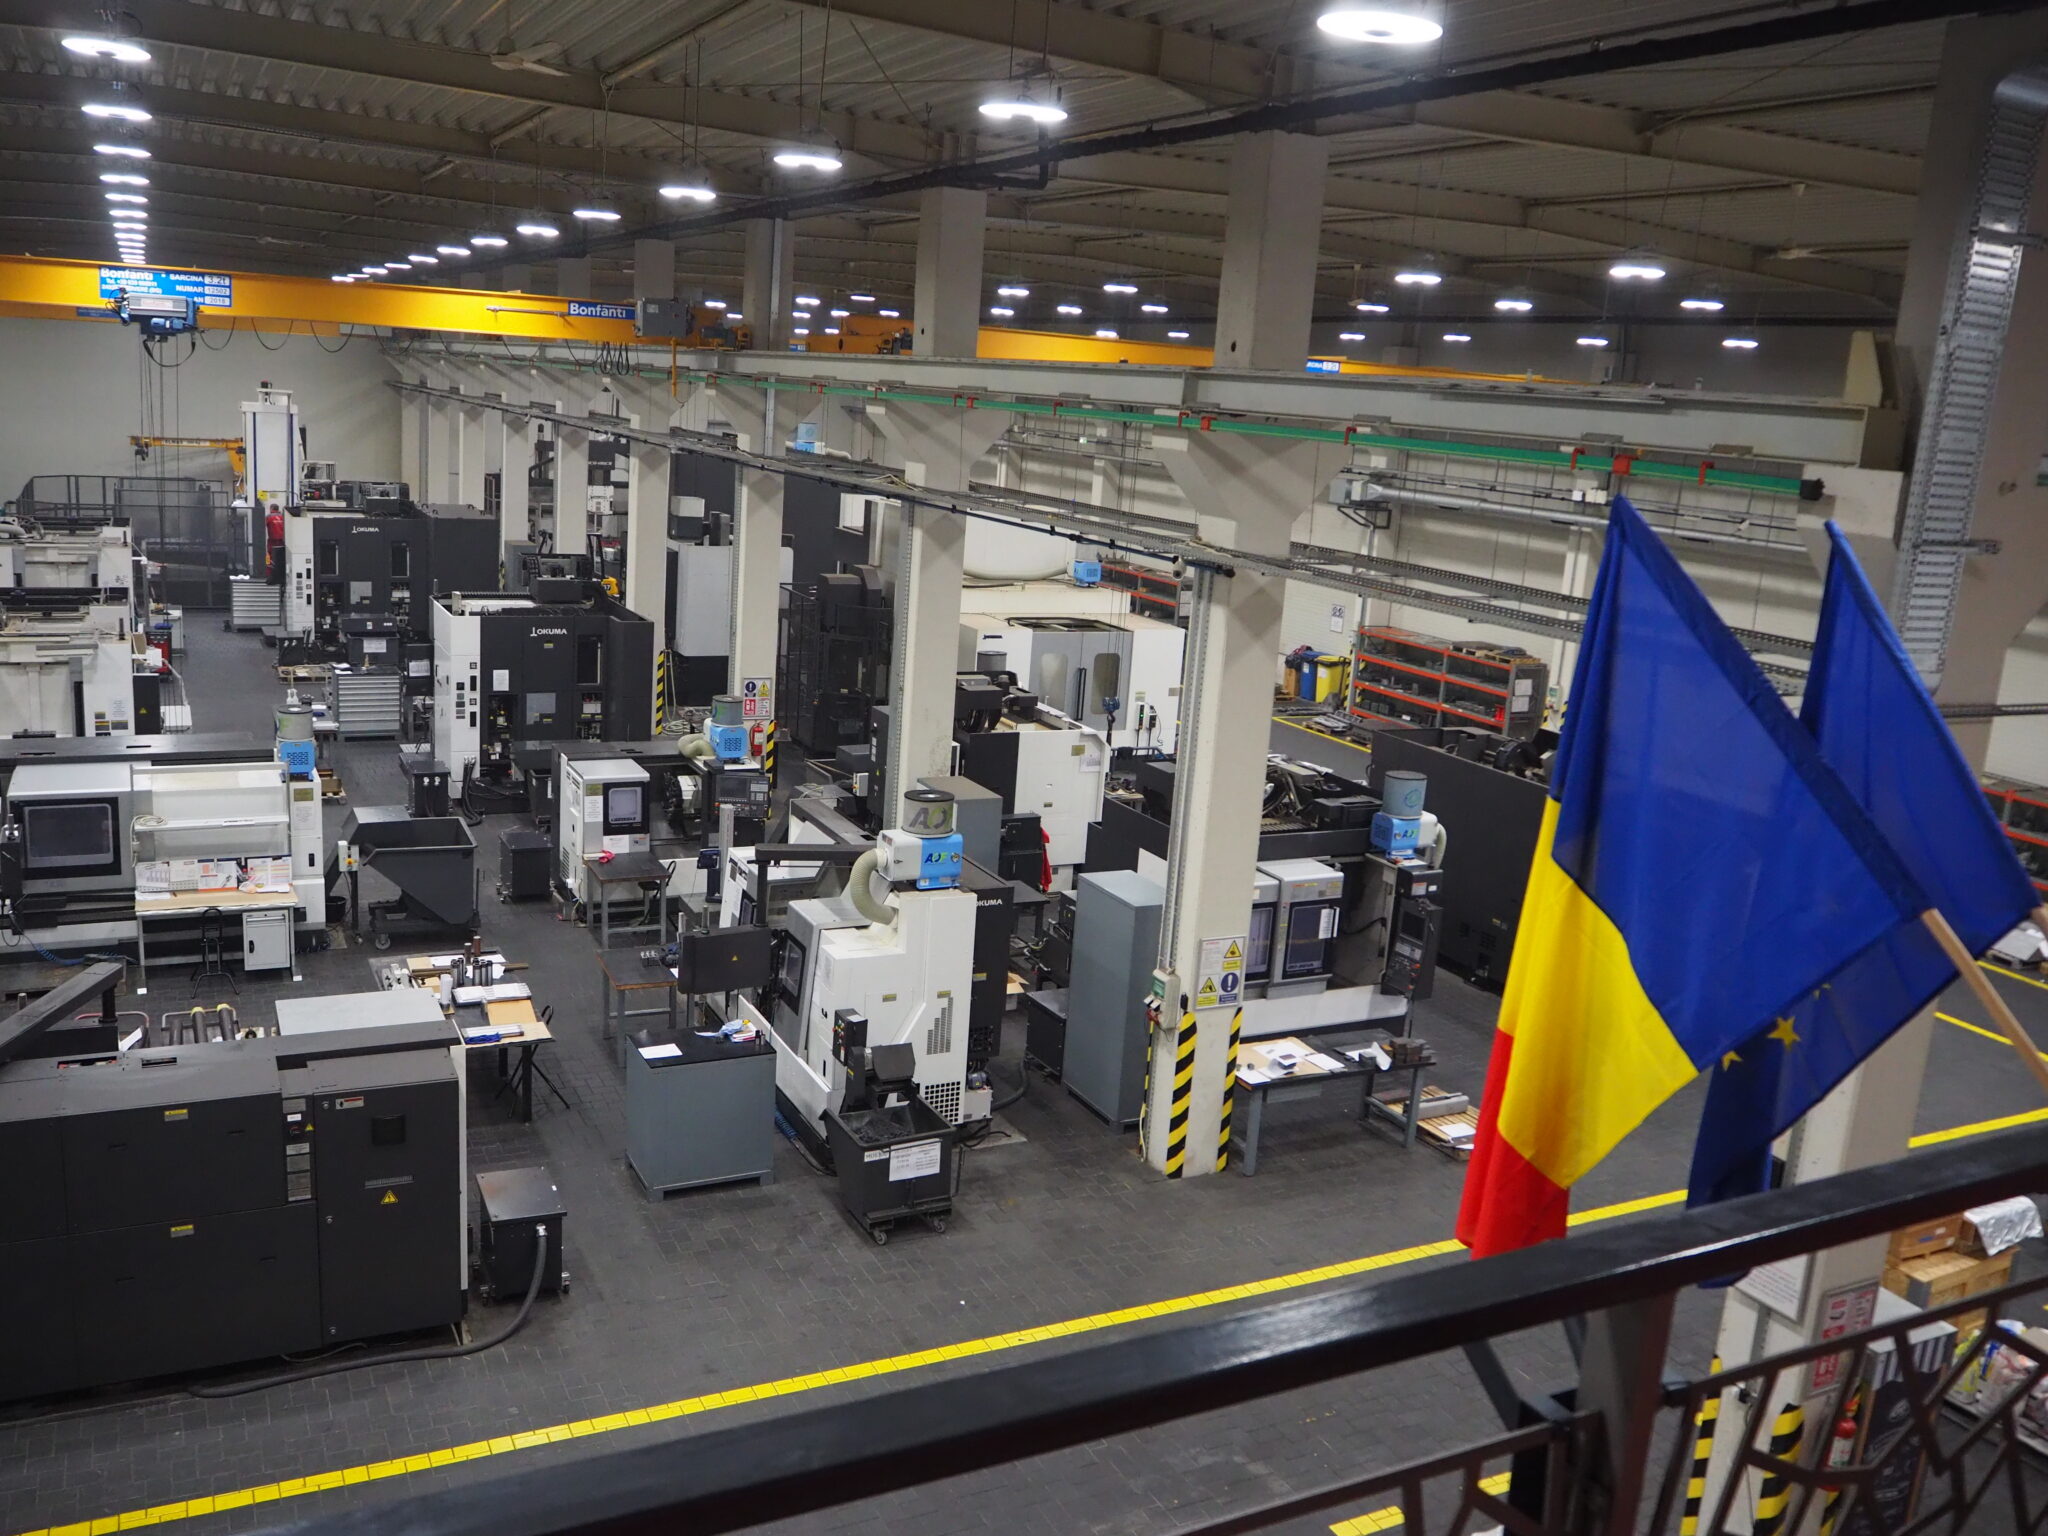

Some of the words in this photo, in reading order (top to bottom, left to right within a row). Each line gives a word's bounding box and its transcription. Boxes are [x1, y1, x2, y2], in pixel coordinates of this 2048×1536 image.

[100, 268, 153, 280] Bonfanti
[170, 273, 204, 282] SARCINA
[175, 285, 204, 293] NUMAR
[570, 302, 626, 318] Bonfanti
